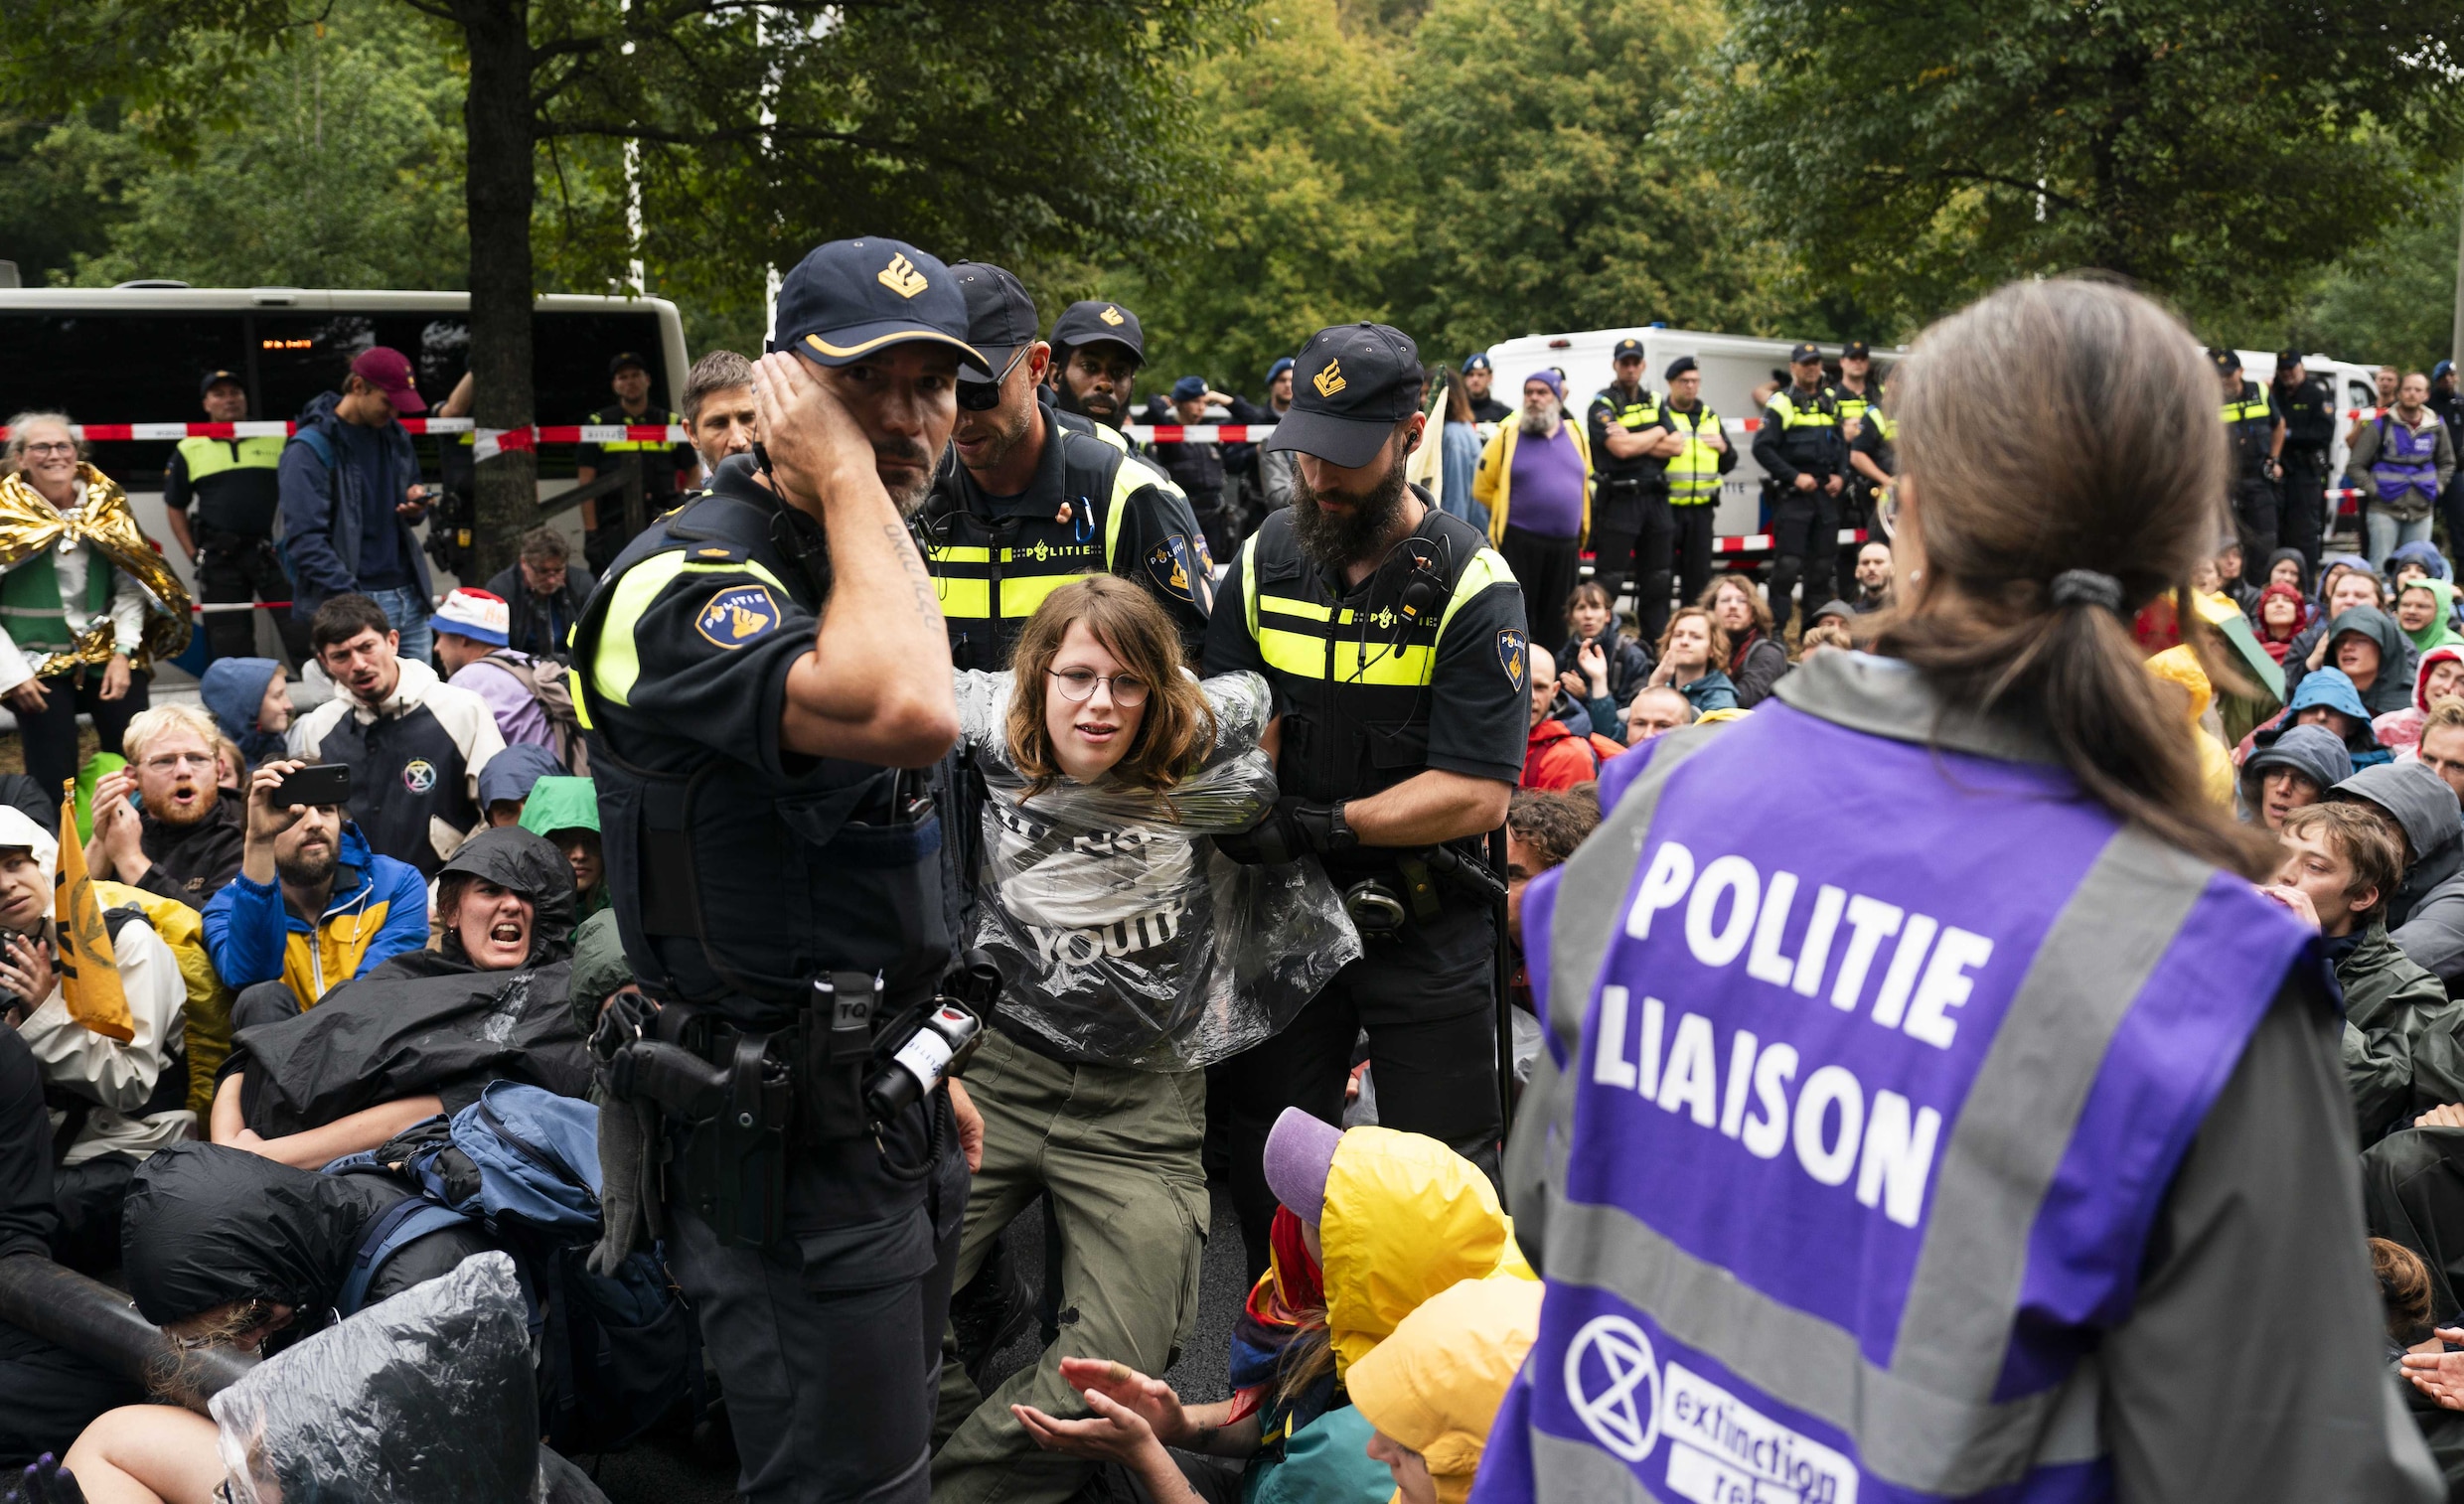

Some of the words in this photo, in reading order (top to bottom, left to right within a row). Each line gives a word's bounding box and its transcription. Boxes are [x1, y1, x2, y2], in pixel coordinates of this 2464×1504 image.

[1026, 541, 1091, 562] POLITIE
[703, 593, 766, 630] POLITIE
[1625, 840, 1994, 1050] POLITIE
[840, 1002, 867, 1019] TQ
[1594, 984, 1942, 1229] LIAISON
[1675, 1391, 1838, 1502] extinction
